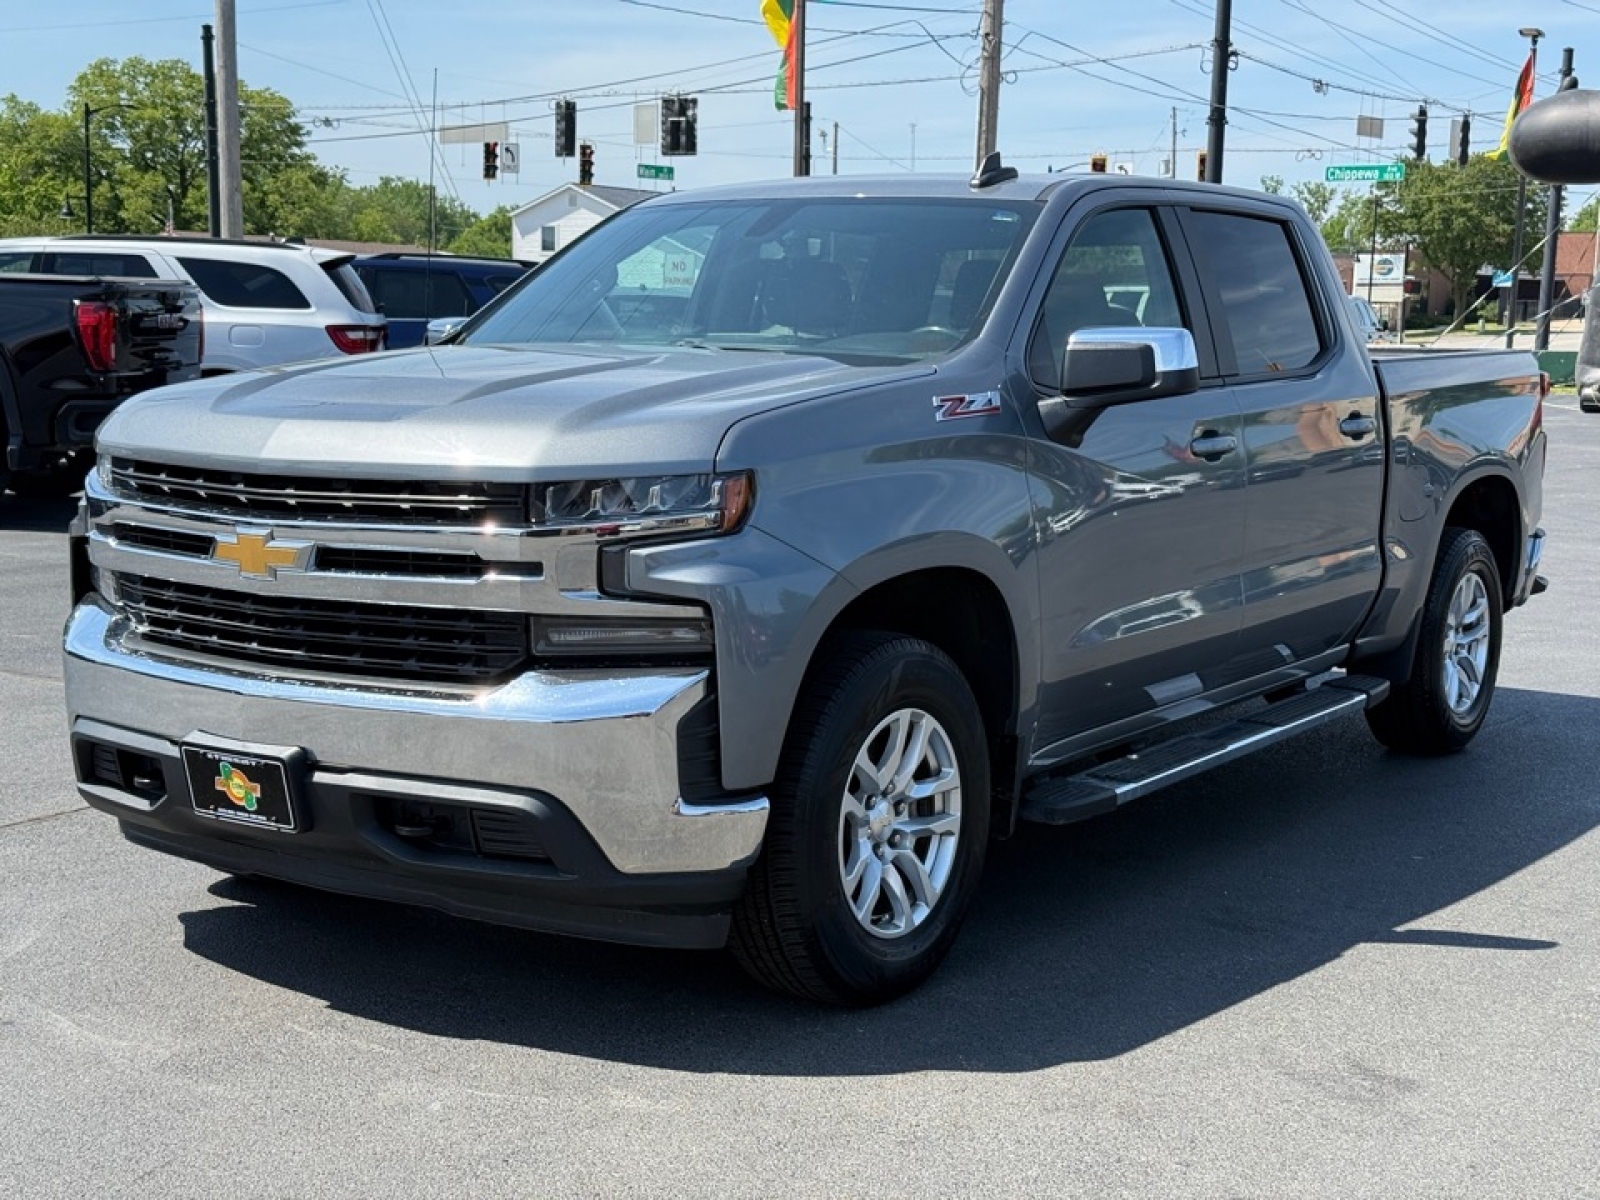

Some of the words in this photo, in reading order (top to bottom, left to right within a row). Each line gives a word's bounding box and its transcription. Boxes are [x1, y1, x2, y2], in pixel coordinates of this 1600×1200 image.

[1328, 167, 1379, 181] Chippewa
[671, 261, 687, 272] NO
[932, 391, 1002, 421] Z71
